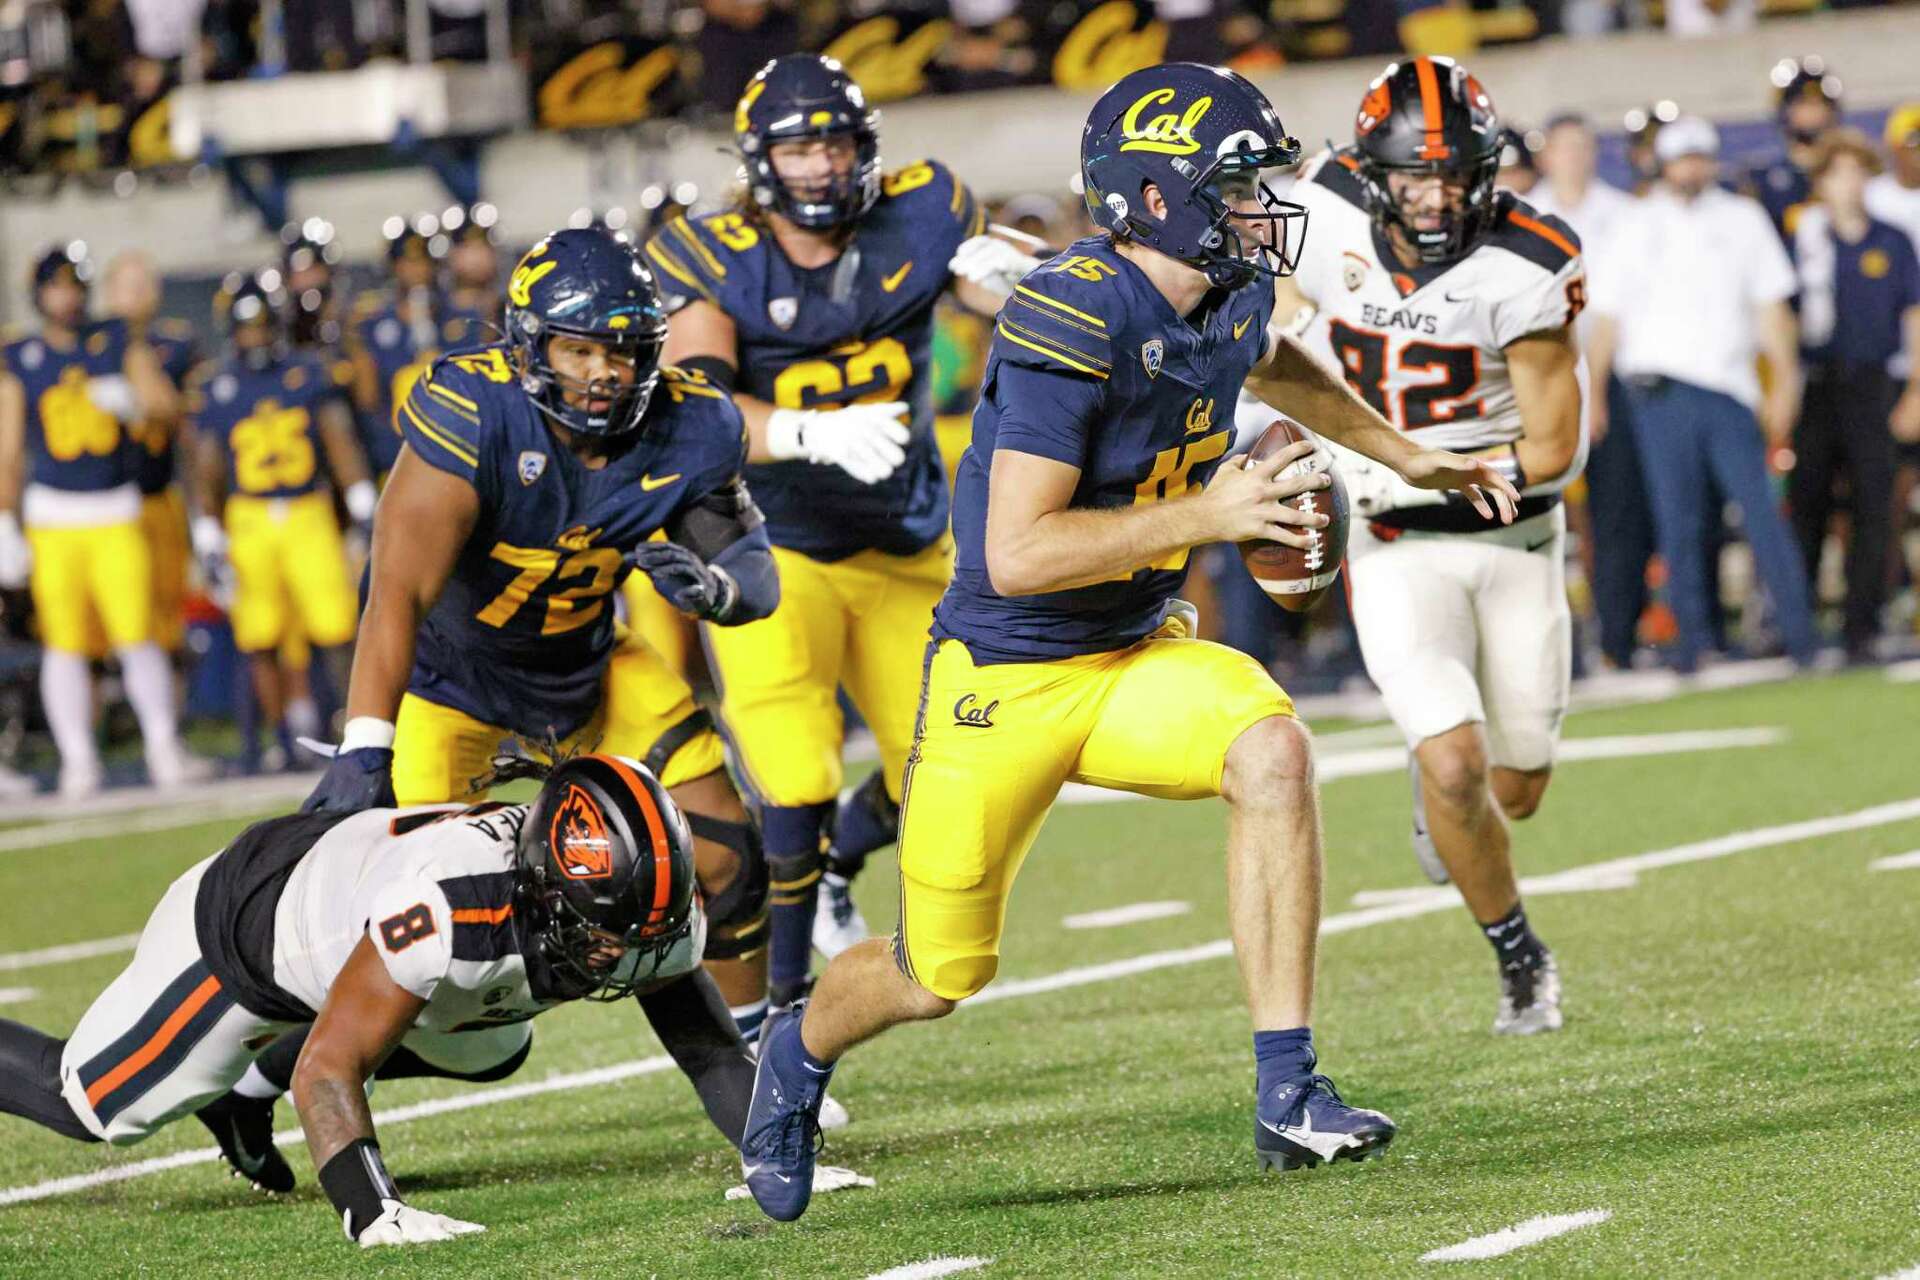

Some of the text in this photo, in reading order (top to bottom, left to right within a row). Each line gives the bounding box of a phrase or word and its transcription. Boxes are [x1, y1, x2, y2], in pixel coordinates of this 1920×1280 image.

[1120, 87, 1213, 156] Cal
[1051, 255, 1118, 282] 15
[1361, 303, 1438, 335] BEAVS
[1184, 398, 1214, 436] Cal
[475, 541, 625, 635] 72
[953, 693, 1000, 728] Cal
[378, 902, 438, 955] 8
